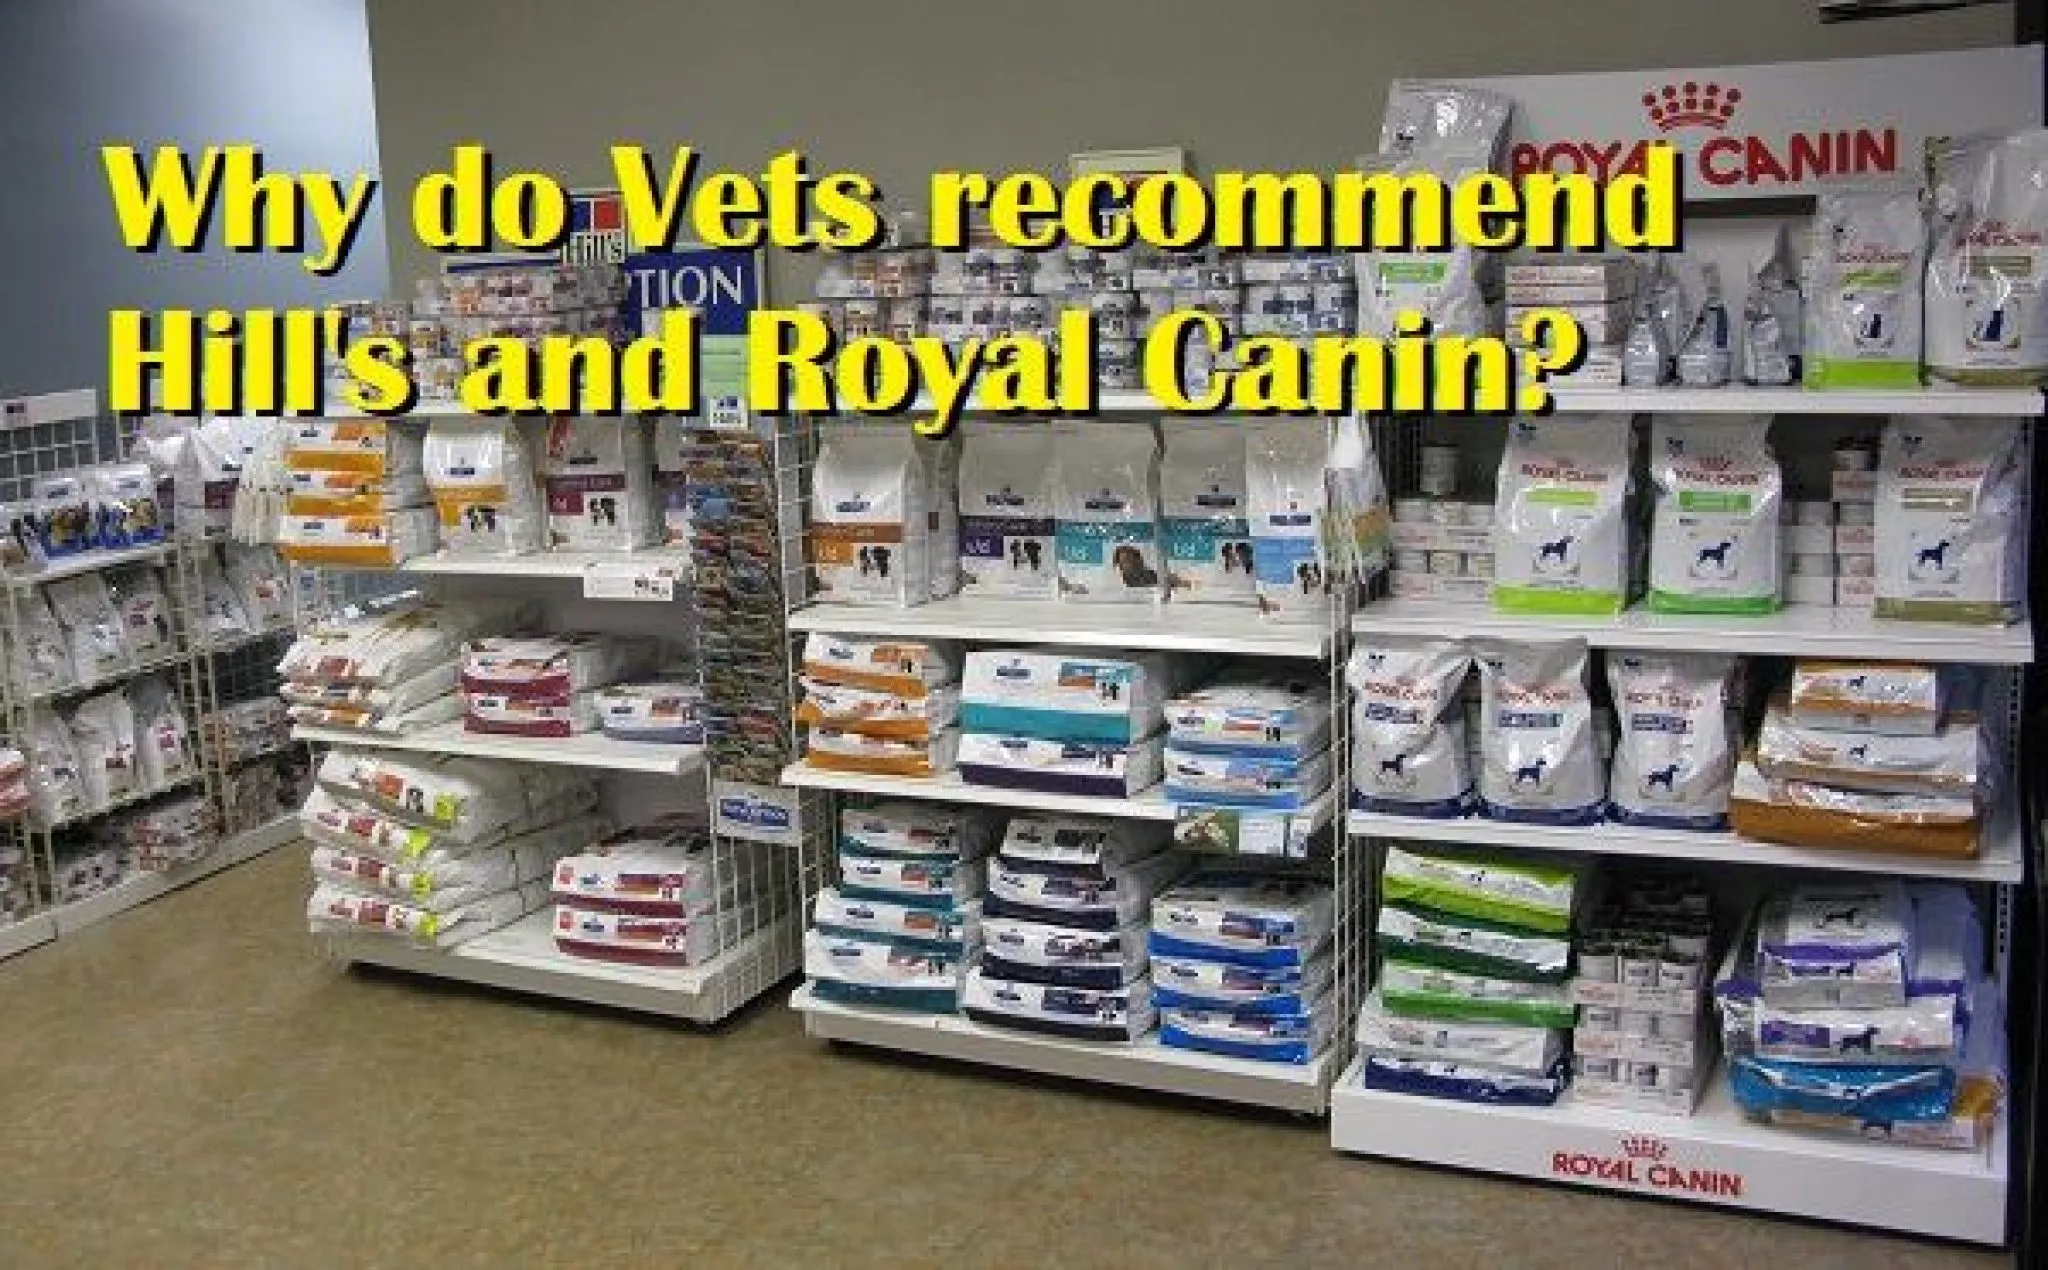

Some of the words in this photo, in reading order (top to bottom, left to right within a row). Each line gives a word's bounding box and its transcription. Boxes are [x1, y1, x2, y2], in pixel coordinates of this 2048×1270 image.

[1699, 128, 1896, 186] CANIN
[625, 263, 743, 309] TION
[1551, 1151, 1641, 1184] ROYAL
[1647, 1162, 1744, 1197] CANIN
